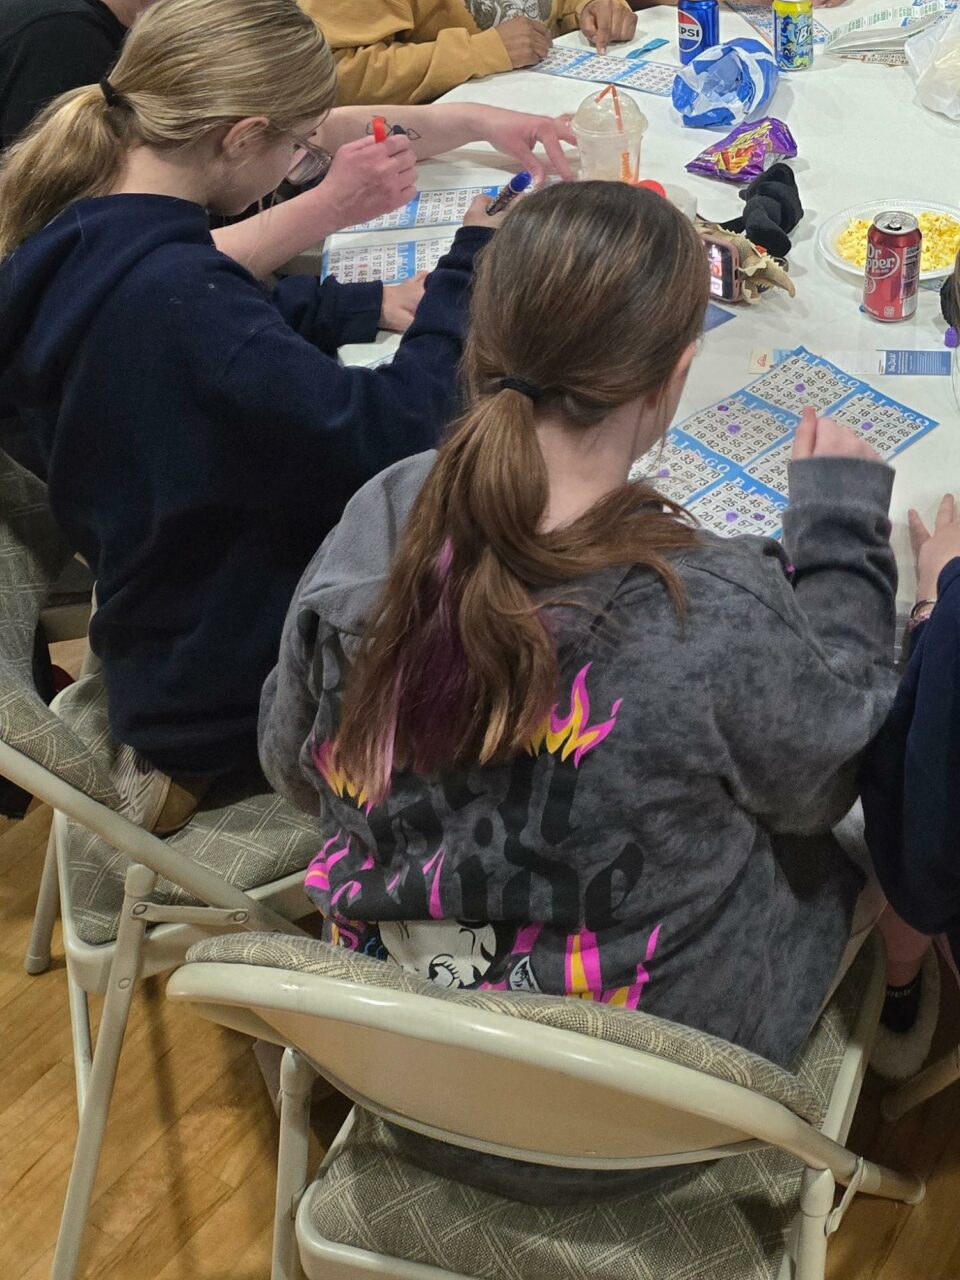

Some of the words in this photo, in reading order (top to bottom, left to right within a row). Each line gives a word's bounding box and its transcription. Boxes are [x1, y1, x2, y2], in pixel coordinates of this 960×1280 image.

[867, 243, 882, 259] Dr
[749, 385, 761, 394] 13
[761, 391, 773, 400] 20
[760, 379, 771, 387] 10
[783, 391, 796, 400] 39
[780, 365, 791, 373] 12
[792, 371, 804, 379] 18
[803, 377, 816, 387] 35
[829, 392, 841, 400] 70
[814, 370, 826, 380] 43
[826, 378, 838, 387] 59
[839, 385, 852, 393] 72
[858, 408, 870, 417] 18
[867, 402, 879, 410] 21
[880, 410, 893, 418] 34
[907, 422, 920, 430] 68
[693, 416, 705, 424] 14
[704, 424, 717, 432] 29
[716, 431, 730, 441] 35
[742, 446, 756, 455] 72
[836, 409, 847, 418] 11
[847, 416, 860, 425] 28
[875, 429, 887, 437] 46
[887, 435, 901, 444] 64
[694, 430, 707, 439] 19
[706, 439, 719, 449] 42
[754, 440, 767, 448] 61
[877, 442, 891, 451] 63
[668, 434, 730, 473] BINGO
[668, 444, 681, 455] 30
[680, 454, 694, 465] 33
[706, 470, 721, 479] 70
[748, 466, 758, 474] 6
[759, 474, 774, 483] 29
[770, 466, 785, 476] 24
[722, 482, 735, 491] 15
[734, 490, 749, 500] 23
[749, 500, 763, 508] 45
[700, 497, 712, 507] 12
[712, 504, 727, 514] 17
[738, 520, 753, 528] 57
[712, 490, 722, 498] 3
[722, 497, 737, 507] 25
[736, 506, 751, 515] 39
[765, 520, 778, 528] 61
[700, 512, 714, 522] 20
[713, 520, 727, 532] 44
